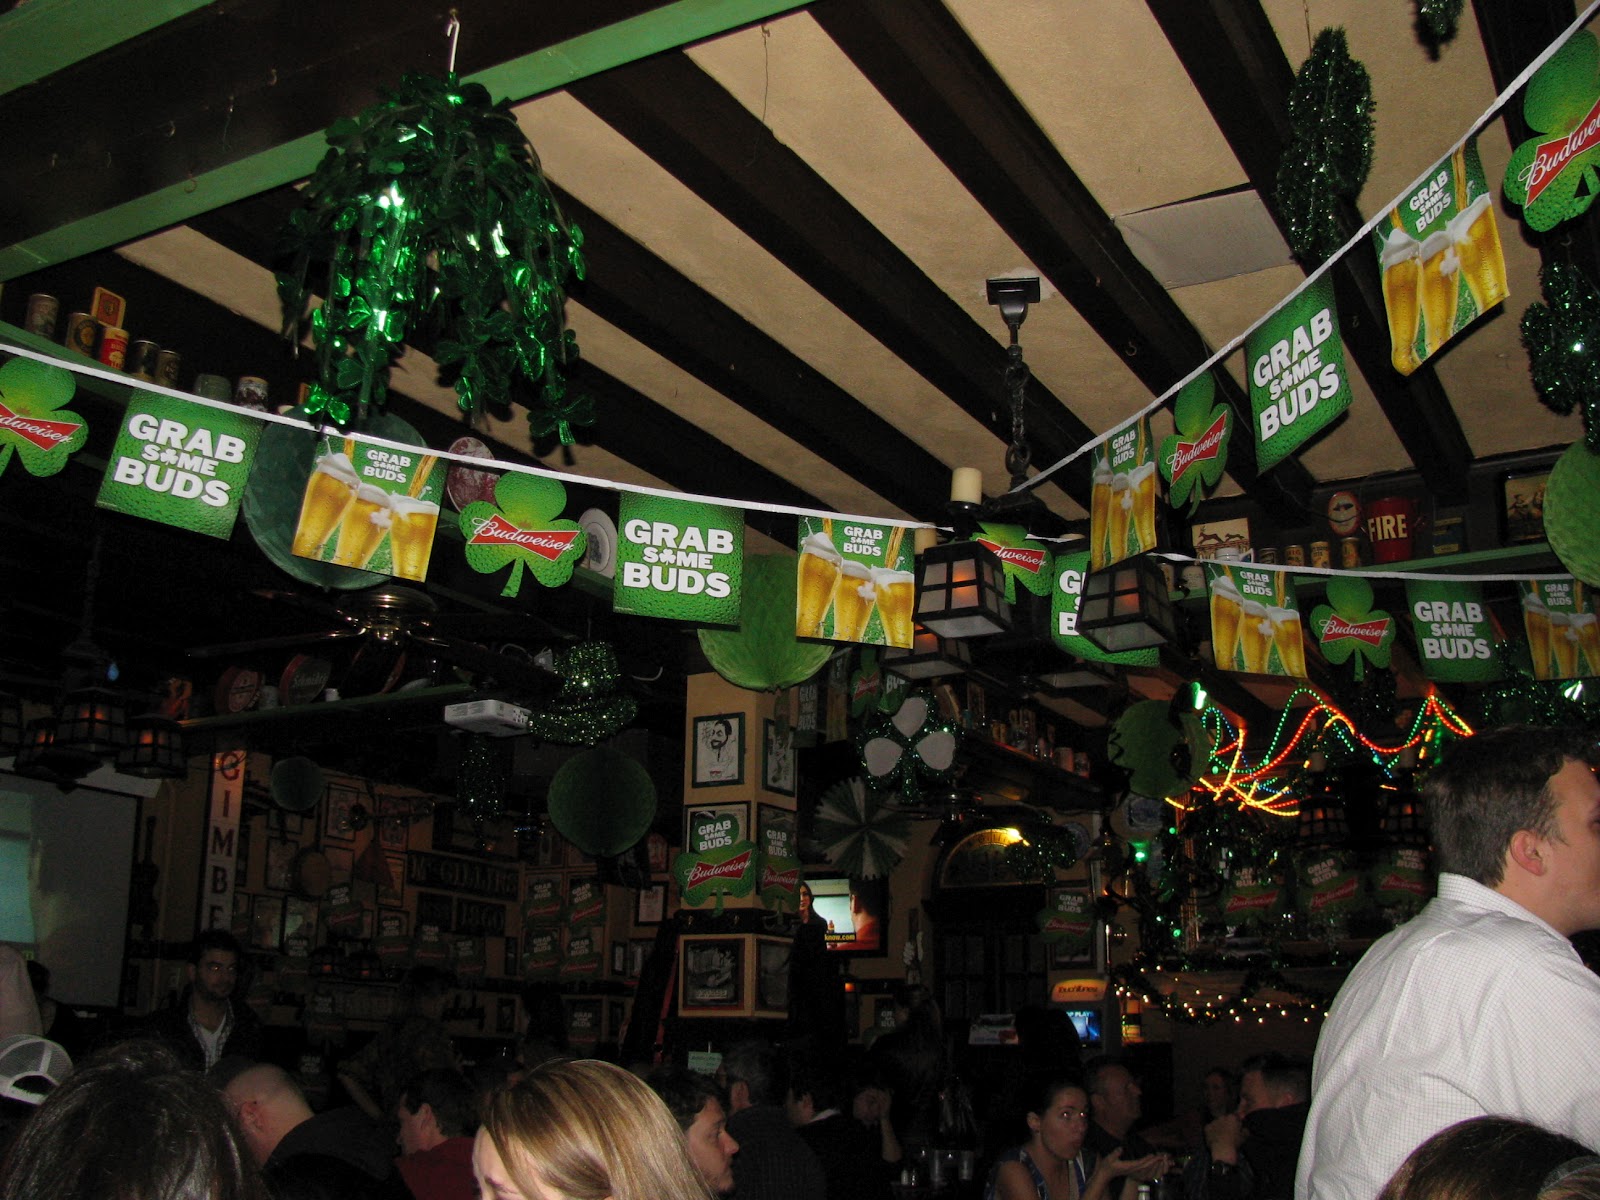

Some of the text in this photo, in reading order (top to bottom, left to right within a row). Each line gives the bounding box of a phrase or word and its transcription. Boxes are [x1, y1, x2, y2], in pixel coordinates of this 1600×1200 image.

[1410, 171, 1448, 211] GRAB
[1415, 192, 1451, 233] BUDS
[1253, 308, 1333, 388] GRAB
[1259, 363, 1340, 442] BUDS
[0, 415, 74, 442] dweiser
[128, 413, 246, 463] GRAB
[1112, 430, 1136, 449] GRAB
[1166, 427, 1227, 472] Budweiser
[367, 450, 411, 467] GRAB
[1112, 448, 1135, 467] BUDS
[113, 457, 231, 507] BUDS
[363, 466, 407, 483] BUDS
[472, 517, 574, 552] Budweiser
[624, 519, 734, 554] GRAB
[843, 526, 883, 539] GRAB
[1367, 513, 1408, 542] FIRE
[843, 542, 882, 556] BUDS
[993, 546, 1046, 566] dweiser
[623, 562, 731, 598] BUDS
[1240, 571, 1269, 582] GRAB
[1243, 584, 1272, 597] BUDS
[1544, 584, 1569, 593] GRAB
[1414, 601, 1483, 623] GRAB
[1547, 597, 1572, 606] BUDS
[1319, 617, 1389, 642] Budweiser
[1422, 638, 1490, 659] BUDS
[698, 820, 731, 836] GRAB
[766, 830, 787, 841] GRAB
[699, 836, 732, 851] BUDS
[768, 846, 788, 857] BUDS
[684, 860, 751, 881] Budweiser
